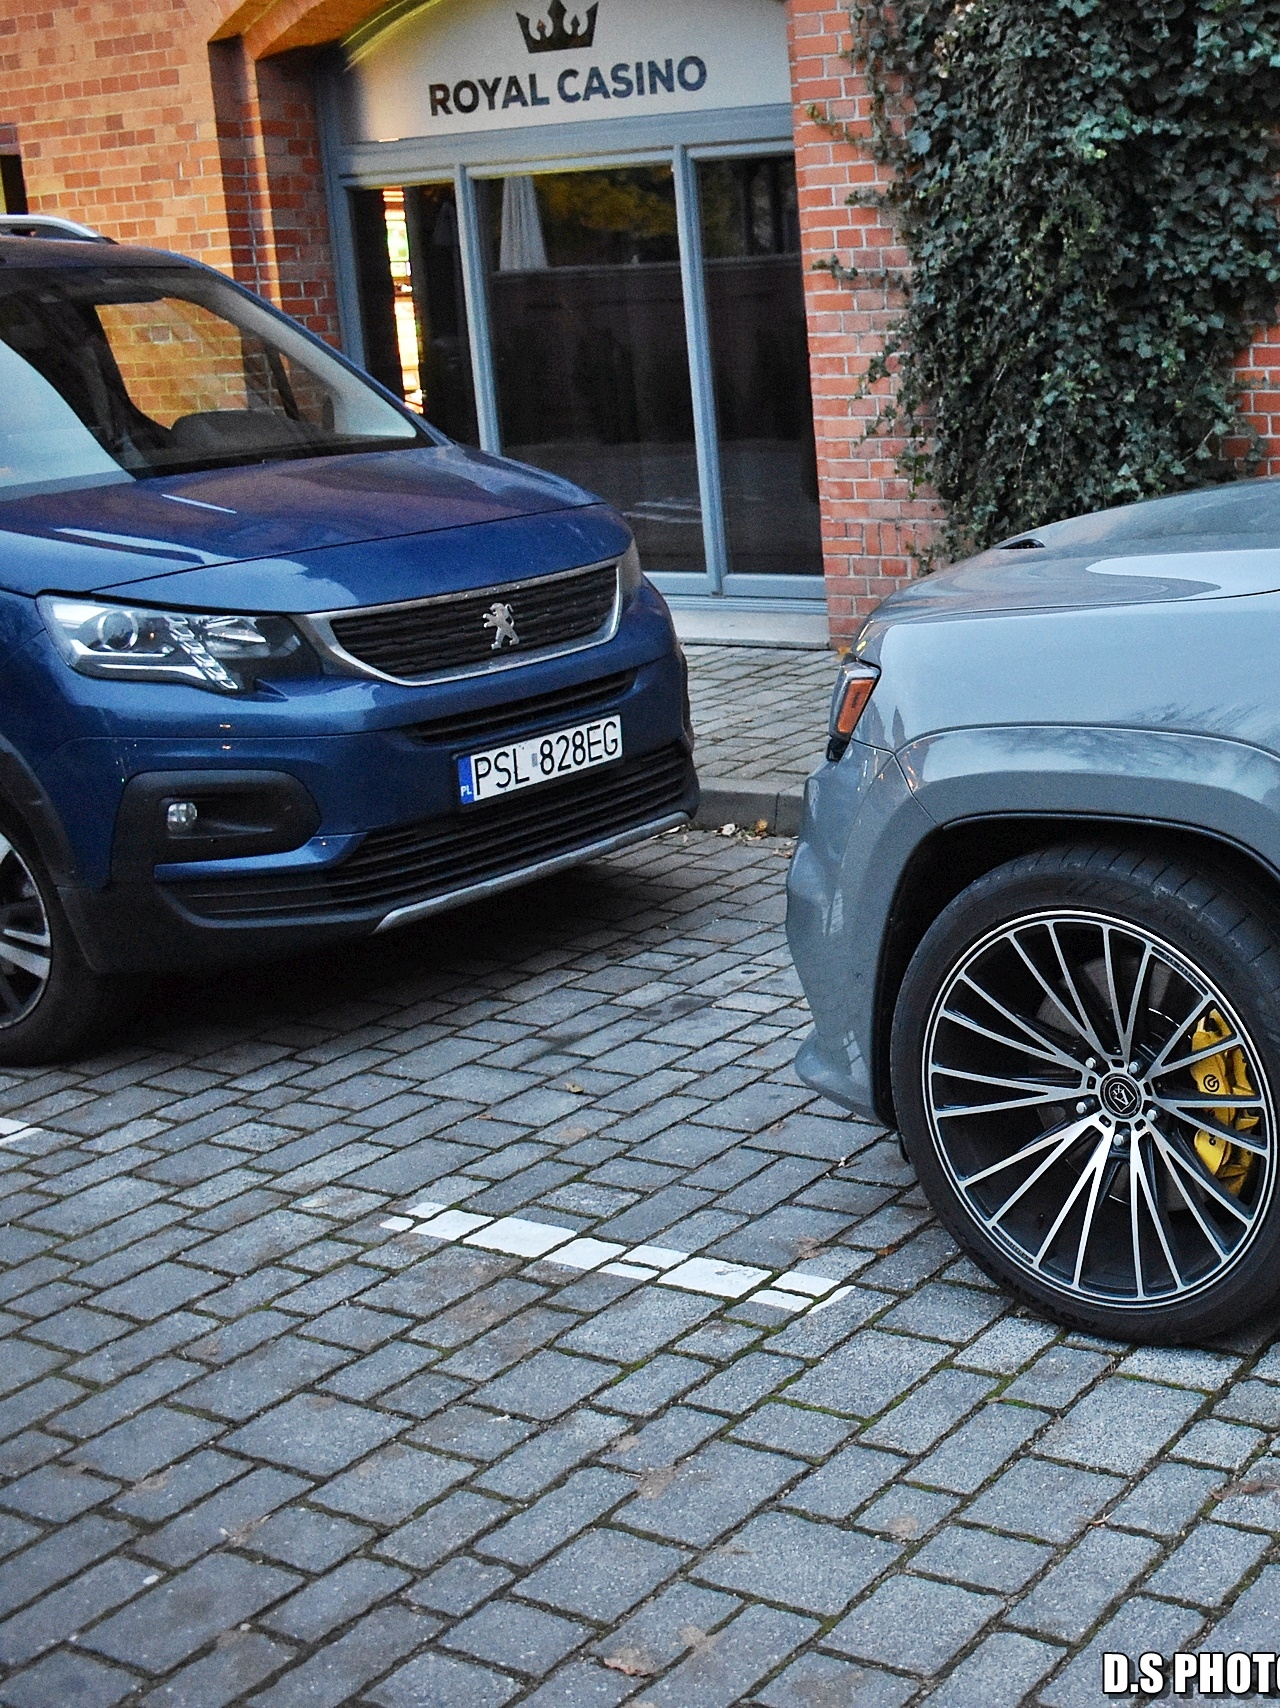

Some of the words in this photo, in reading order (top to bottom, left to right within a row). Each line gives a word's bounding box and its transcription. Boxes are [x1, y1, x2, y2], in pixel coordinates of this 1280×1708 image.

[429, 73, 550, 116] ROYAL
[557, 55, 707, 103] CASINO
[474, 748, 530, 796] PSL
[540, 721, 618, 775] 828EG
[460, 785, 473, 797] PL
